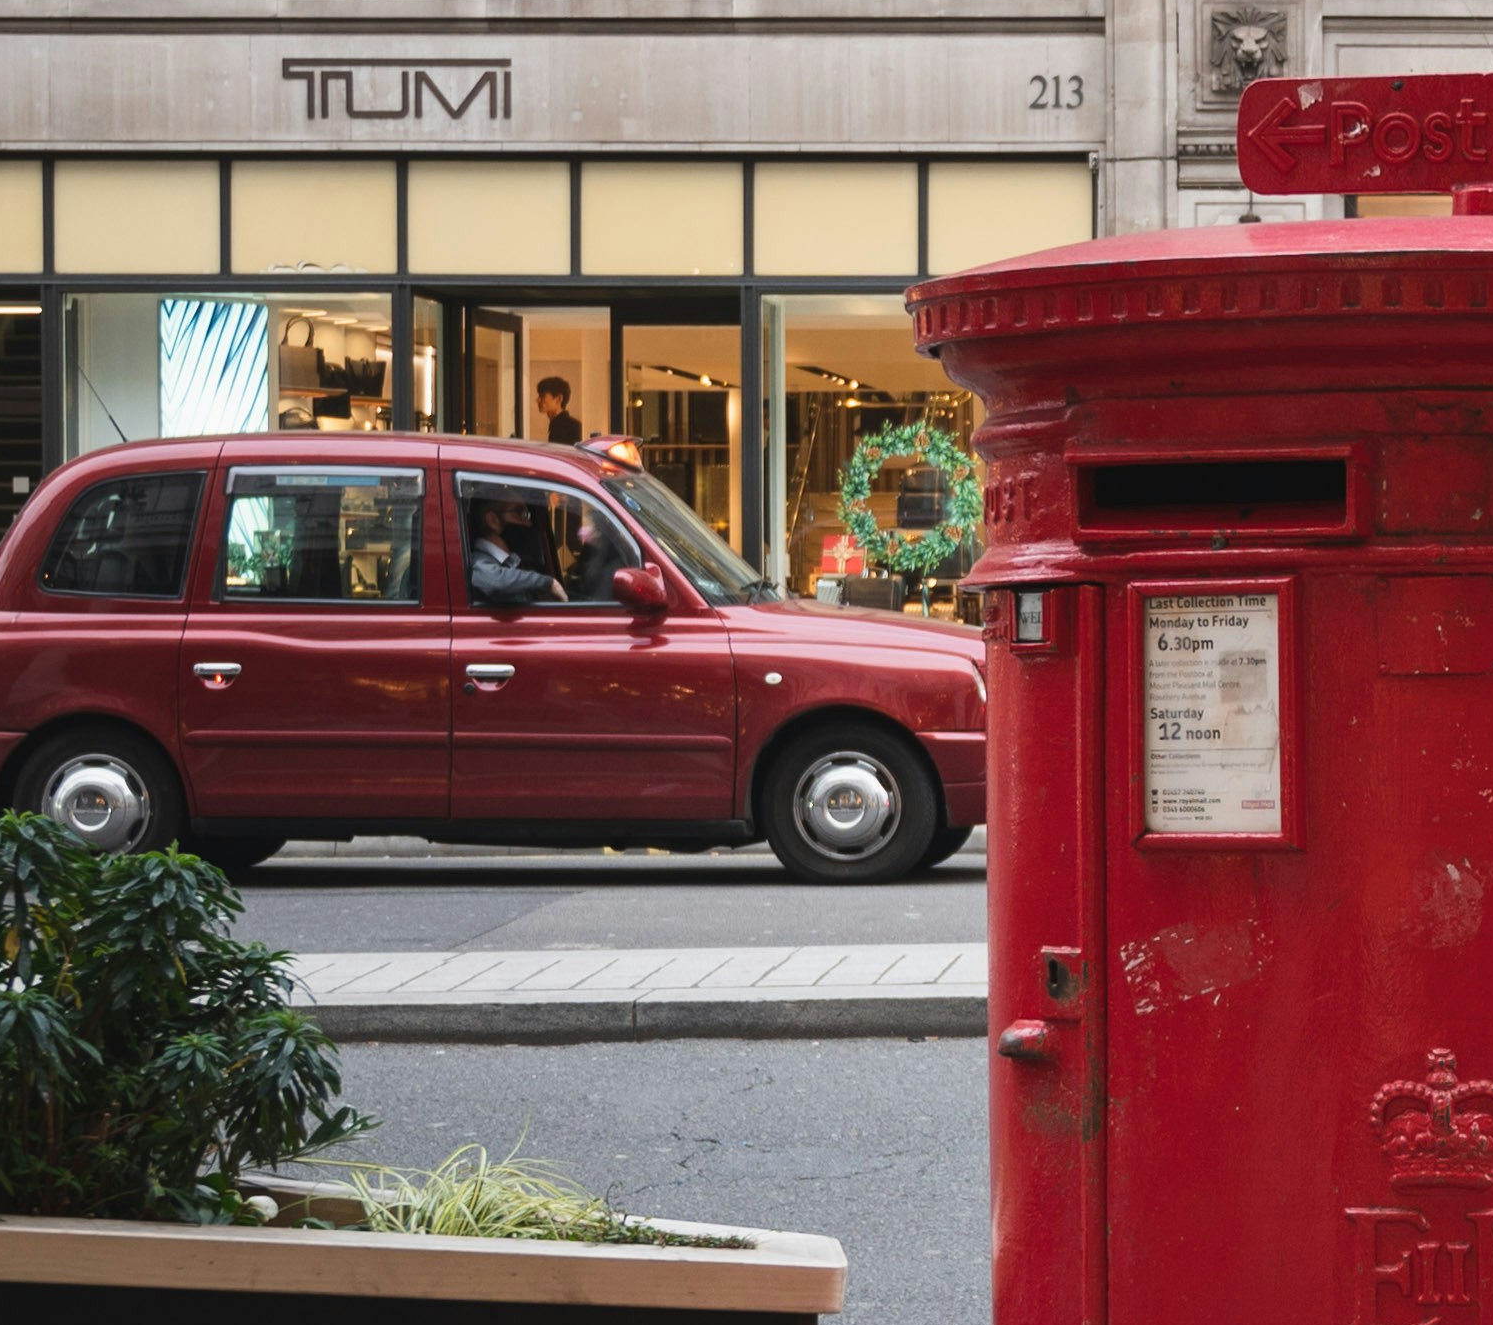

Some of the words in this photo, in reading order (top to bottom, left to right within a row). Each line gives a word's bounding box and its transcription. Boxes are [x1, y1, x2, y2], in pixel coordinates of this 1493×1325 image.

[282, 58, 512, 120] TUMI
[1027, 73, 1085, 112] 213
[1329, 97, 1489, 168] Post
[1149, 596, 1173, 610] Last
[1177, 595, 1234, 609] Collection
[1238, 595, 1267, 607] Time
[1149, 616, 1195, 630] Monday
[1197, 617, 1210, 628] to
[1212, 615, 1249, 629] Friday
[1157, 632, 1214, 653] 6.30pm
[1150, 707, 1204, 721] Saturday
[1158, 722, 1182, 741] 12
[1186, 728, 1221, 740] noon
